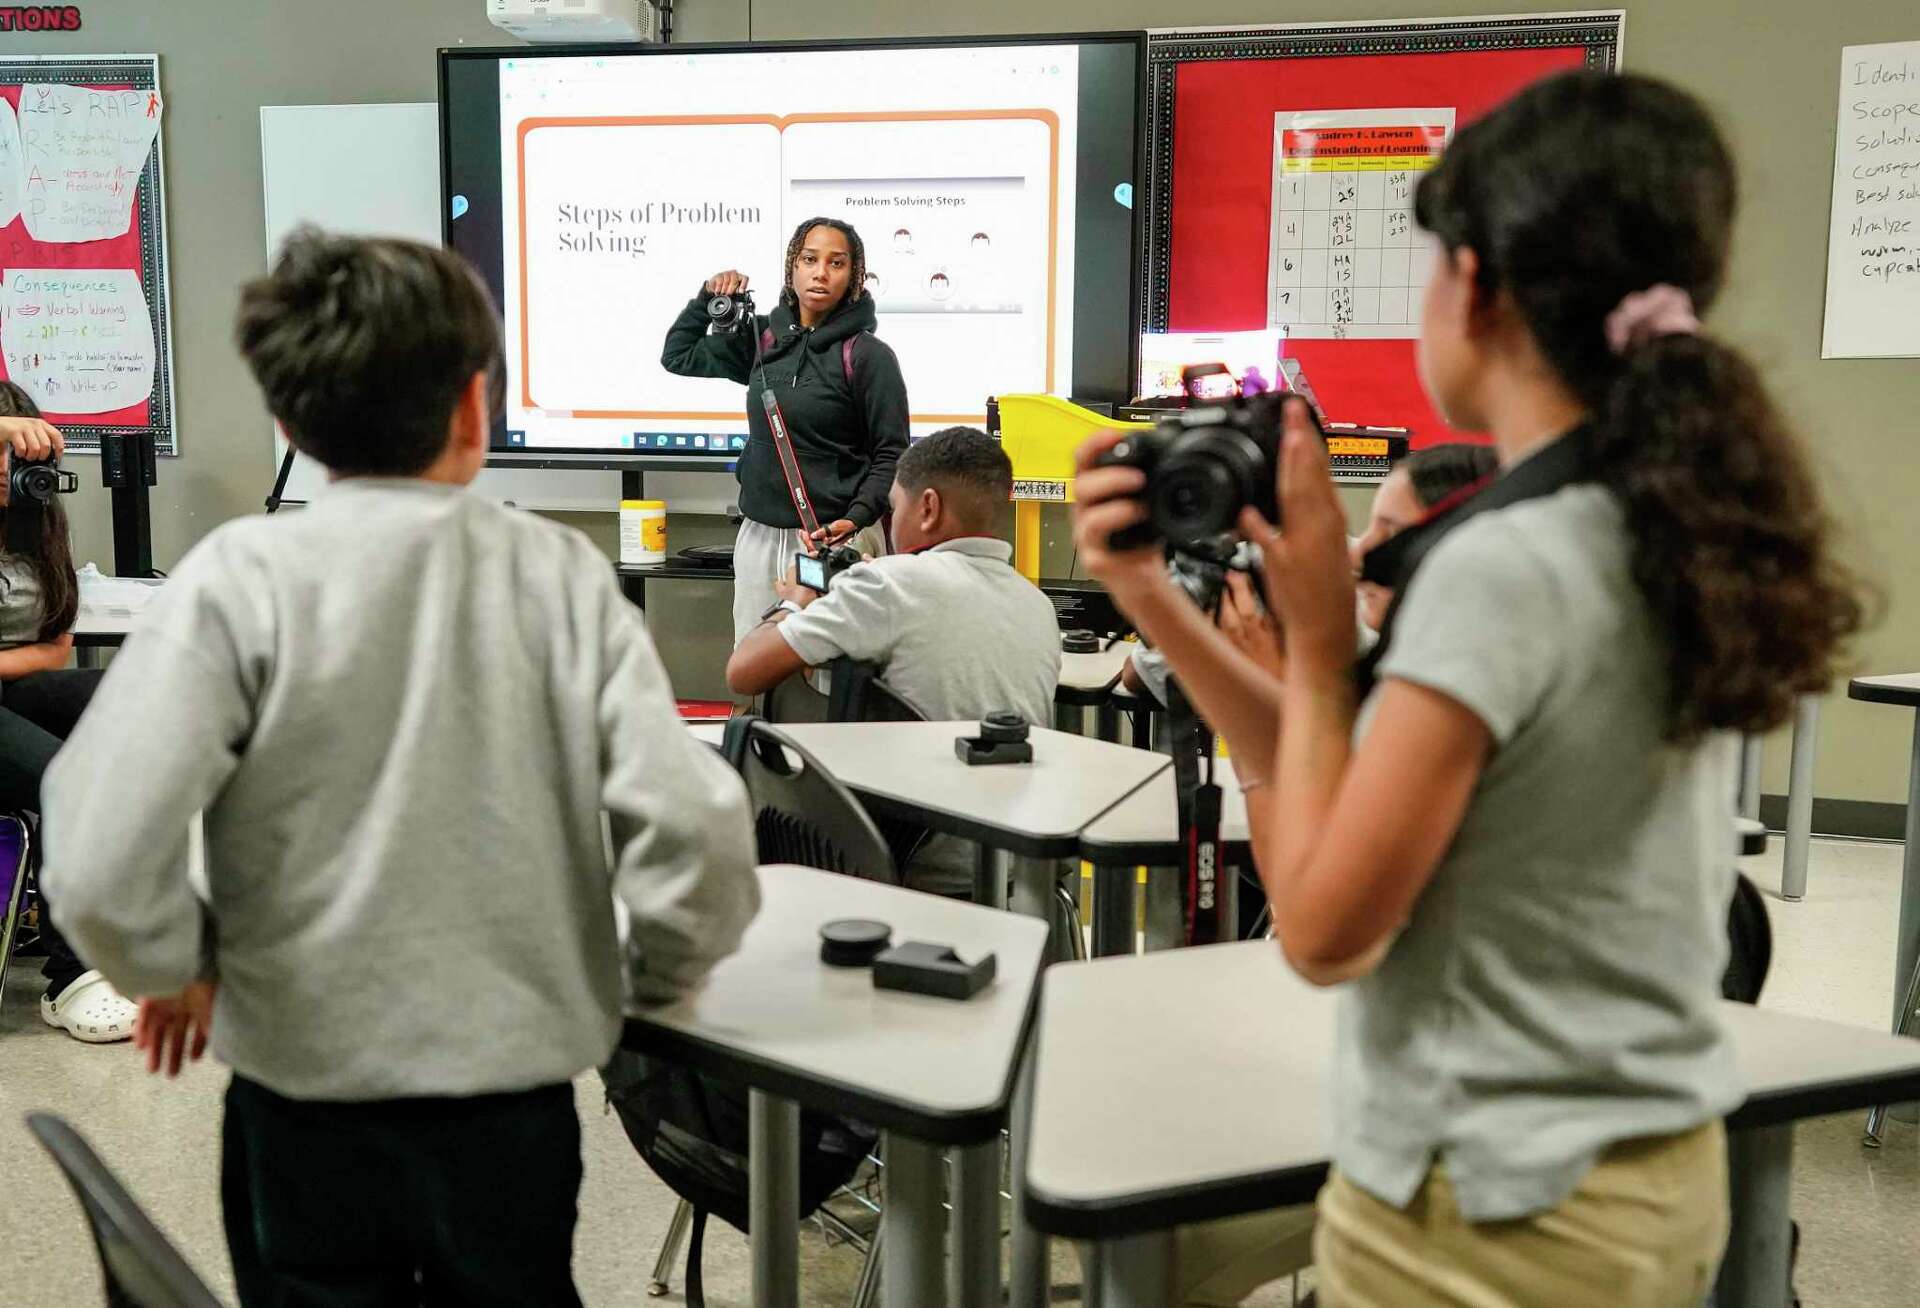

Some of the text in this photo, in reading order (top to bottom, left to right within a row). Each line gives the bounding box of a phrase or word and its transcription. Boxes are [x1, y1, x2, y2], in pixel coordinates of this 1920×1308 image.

[0, 6, 81, 31] TIONS
[89, 92, 141, 119] RAP
[1853, 101, 1920, 124] Scope
[1387, 143, 1438, 153] Learnin
[845, 196, 966, 208] Problem Solving Steps
[559, 202, 761, 230] Steps of Problem
[1287, 221, 1296, 236] 4
[559, 230, 647, 258] Solving
[1284, 257, 1293, 271] 6
[13, 274, 119, 297] Consequences
[772, 414, 784, 438] Canon
[1198, 842, 1214, 881] EOS
